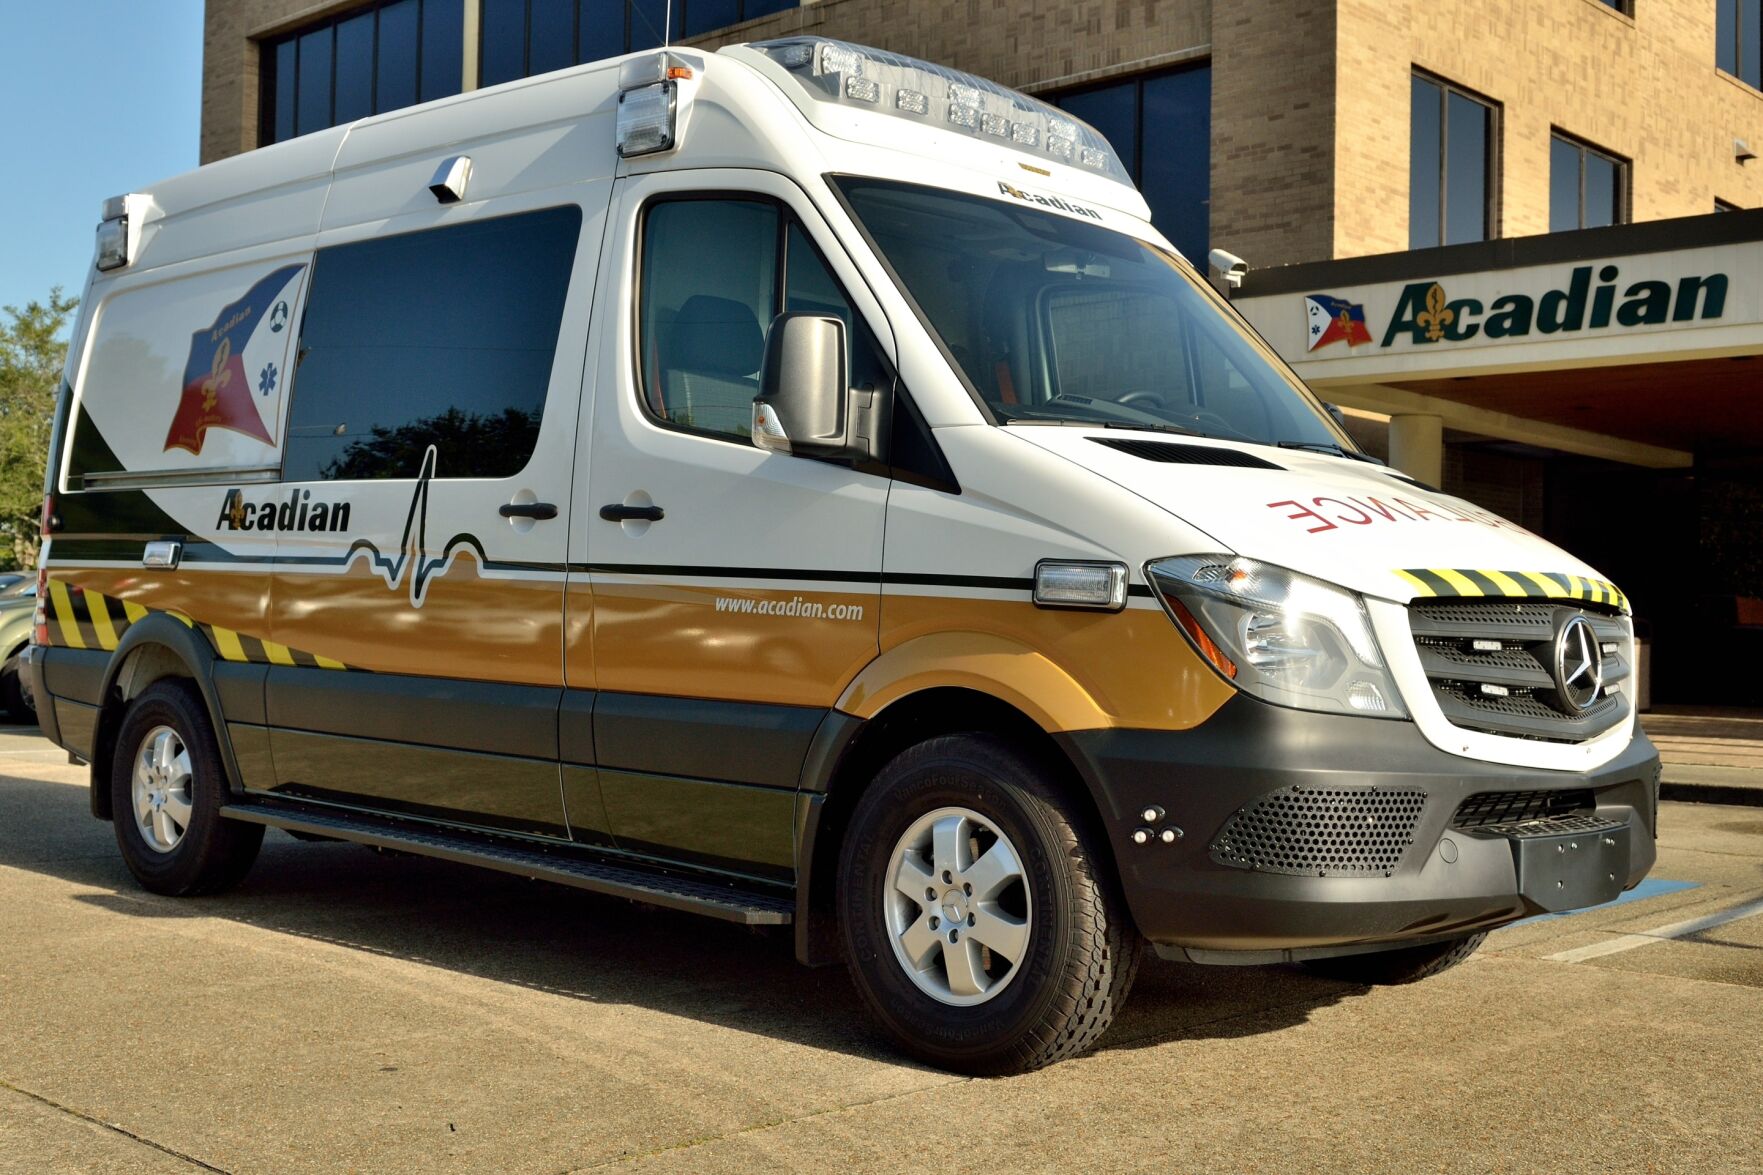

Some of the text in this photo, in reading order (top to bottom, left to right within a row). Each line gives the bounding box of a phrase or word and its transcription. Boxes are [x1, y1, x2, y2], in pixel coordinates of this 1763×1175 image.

[997, 181, 1102, 221] Acadian
[1381, 265, 1729, 347] Acadian
[216, 488, 351, 532] Acadian
[715, 596, 864, 620] www.acadian.com
